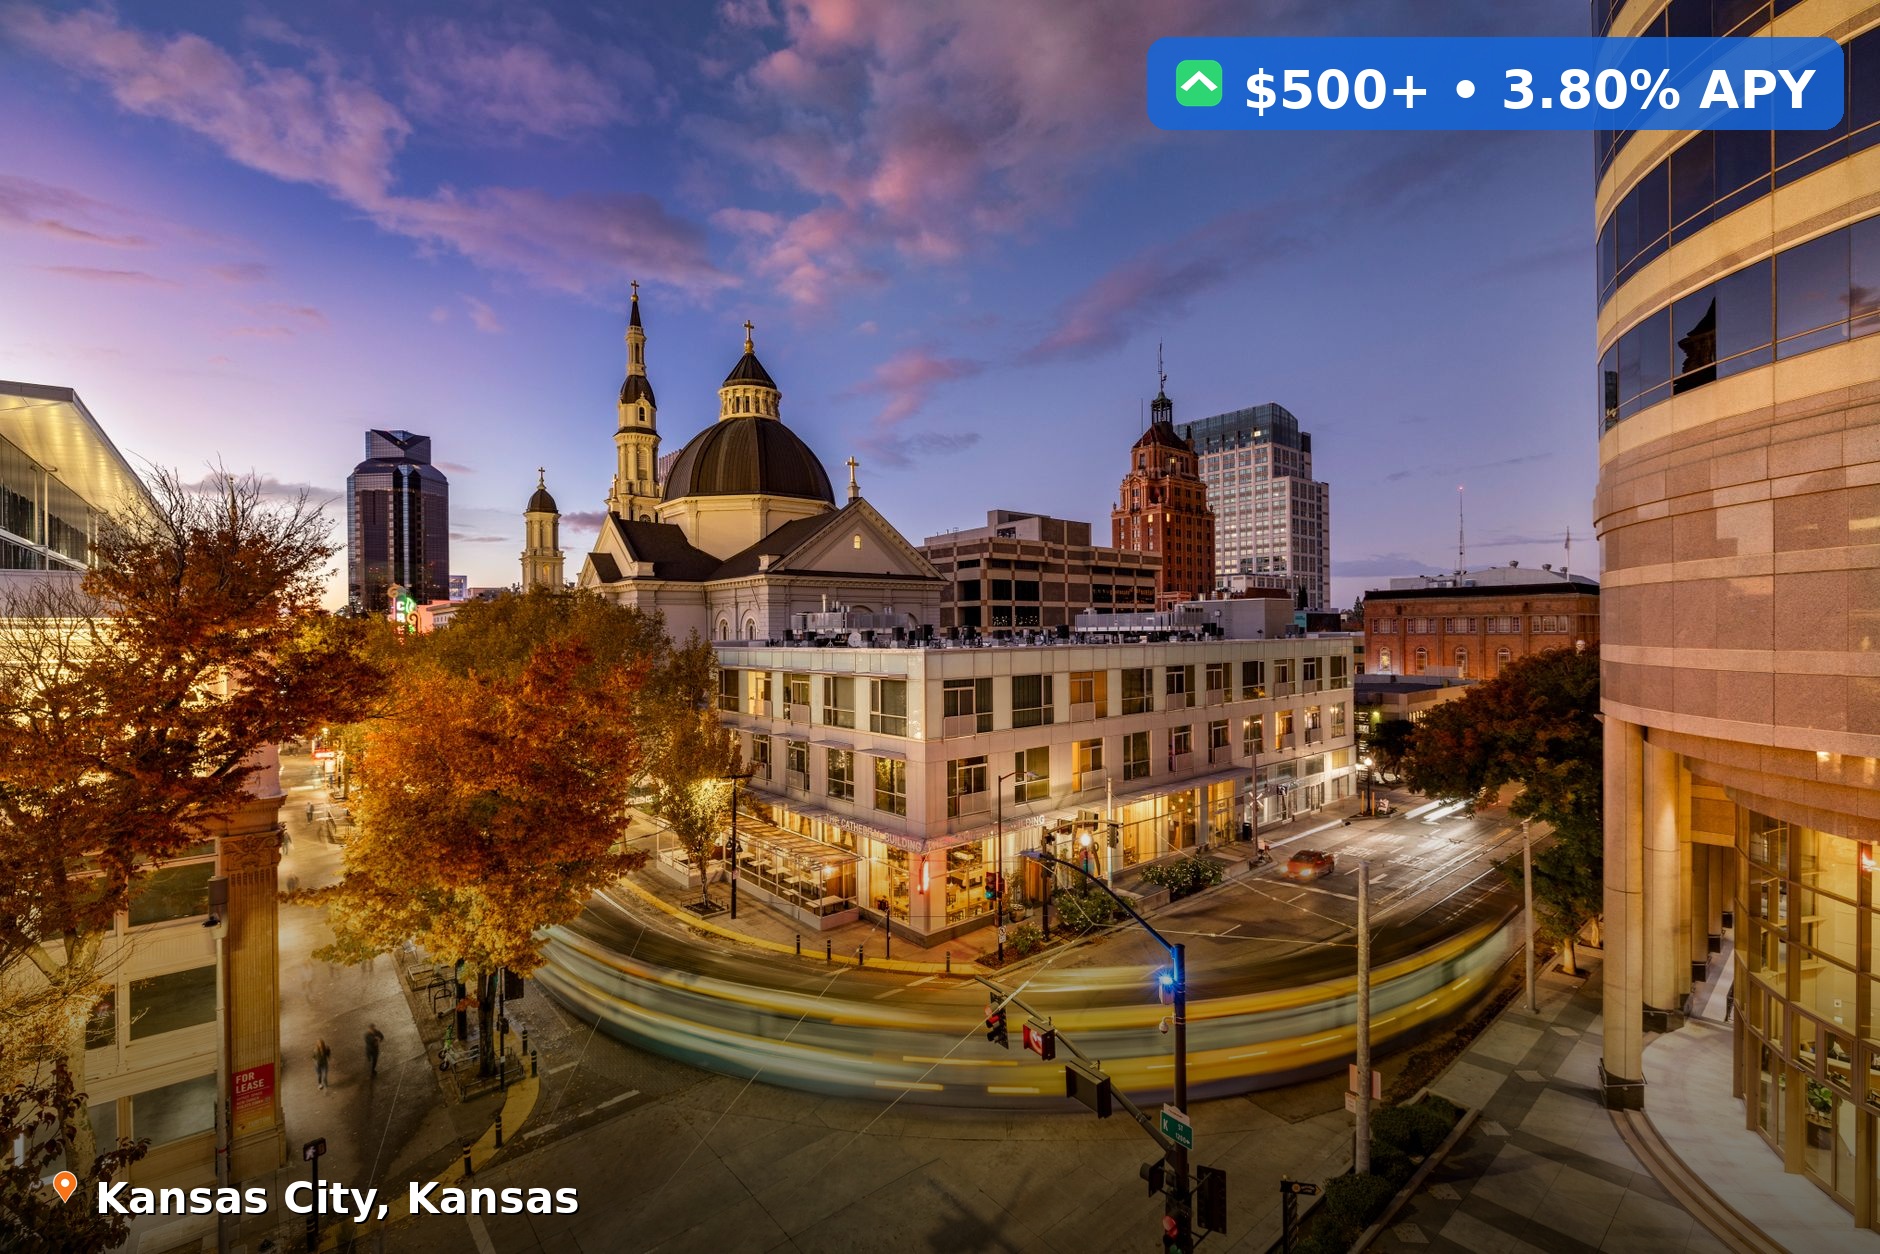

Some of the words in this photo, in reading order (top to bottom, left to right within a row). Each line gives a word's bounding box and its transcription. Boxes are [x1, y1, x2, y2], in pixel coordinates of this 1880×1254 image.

[884, 832, 922, 852] BUILDING
[235, 1072, 255, 1084] FOR
[235, 1079, 264, 1093] LEASE
[1163, 1118, 1169, 1132] K
